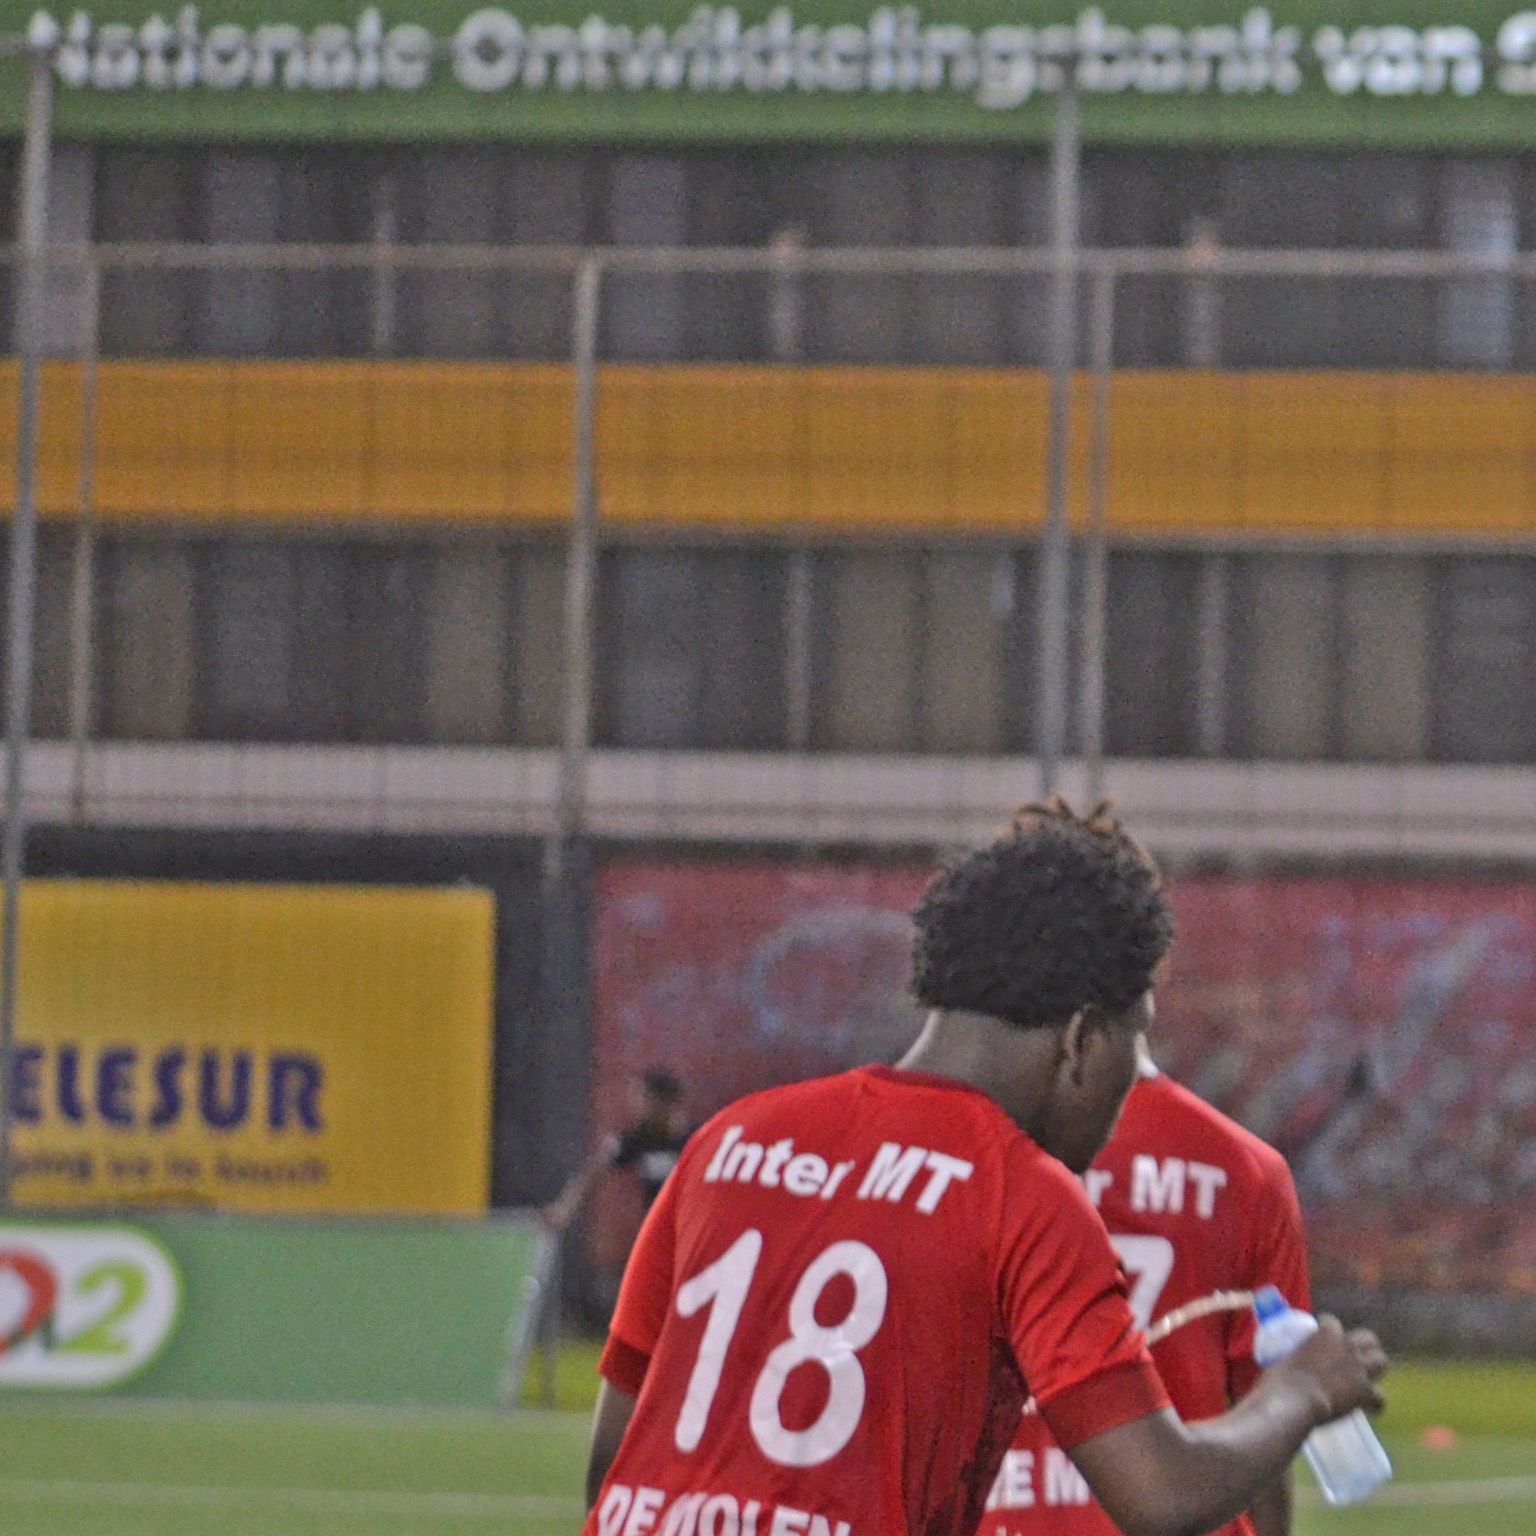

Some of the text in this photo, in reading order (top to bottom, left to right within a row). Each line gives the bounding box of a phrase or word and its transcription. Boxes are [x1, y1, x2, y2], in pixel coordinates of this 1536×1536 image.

[26, 5, 434, 90] Nationale
[453, 5, 1303, 110] Ontwikkelingsbank
[1314, 23, 1482, 95] van
[12, 1041, 324, 1134] ELESUR
[703, 1124, 974, 1216] Inter MT
[1131, 1153, 1228, 1221] MT
[674, 1228, 888, 1467] 18
